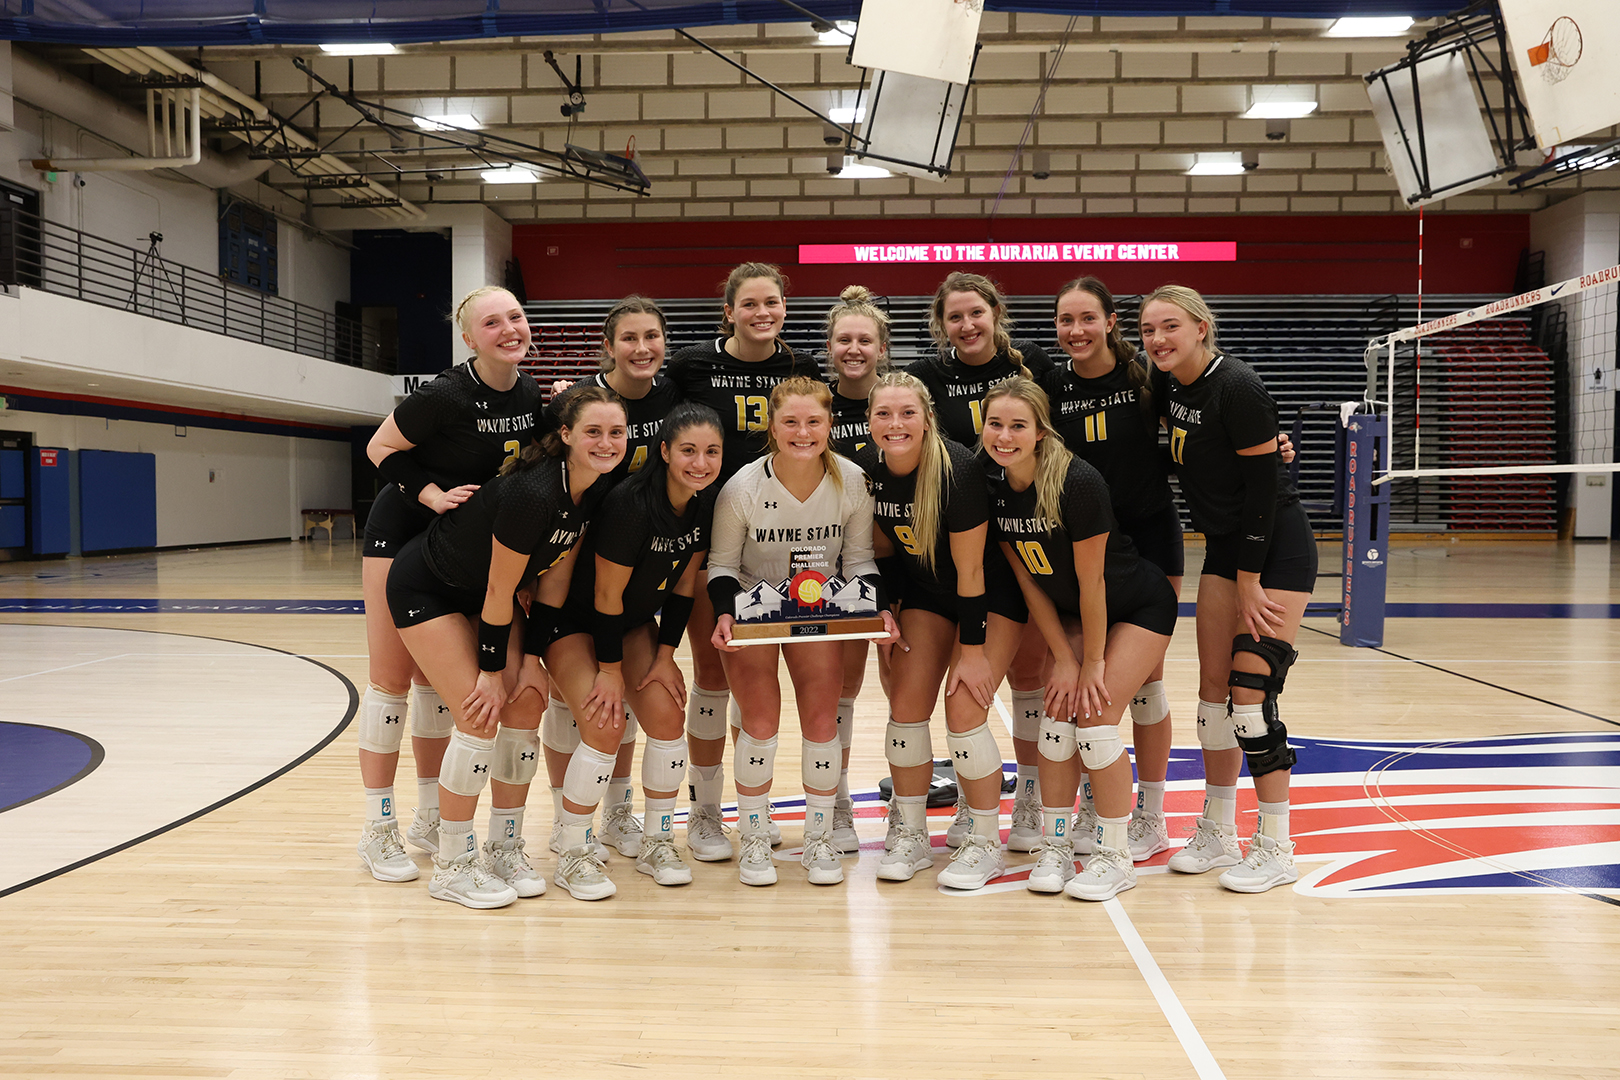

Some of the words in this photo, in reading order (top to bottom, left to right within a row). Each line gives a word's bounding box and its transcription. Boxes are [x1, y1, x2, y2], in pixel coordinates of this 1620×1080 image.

[853, 245, 929, 262] WELCOME
[933, 245, 951, 261] TO
[956, 245, 985, 261] THE
[989, 245, 1058, 260] AURARIA
[1062, 244, 1114, 260] EVENT
[1117, 244, 1179, 260] CENTER
[1579, 265, 1620, 289] ROADRU
[1485, 290, 1542, 315] ROADRUNNERS
[711, 375, 751, 388] WAYNE
[946, 382, 984, 397] WAYNE
[1061, 399, 1096, 415] WAYNE
[1100, 389, 1136, 407] STATE
[476, 418, 510, 433] WAYNE
[512, 412, 535, 432] STATE
[735, 395, 769, 432] 13
[643, 418, 666, 438] STAT
[830, 421, 871, 440] WAYNE
[1085, 410, 1107, 442] 11
[502, 439, 520, 468] 2
[1170, 425, 1188, 466] 17
[628, 445, 648, 473] 4
[875, 501, 902, 518] AYNE
[549, 528, 578, 546] AYN
[756, 528, 802, 543] WAYNE
[894, 525, 923, 556] 9
[1343, 441, 1358, 626] ROADRUNNERS
[790, 545, 827, 553] COLORADO
[793, 553, 824, 561] PREMIER
[1015, 540, 1054, 575] 10
[790, 561, 829, 569] CHALLENGE
[799, 626, 819, 634] 2022
